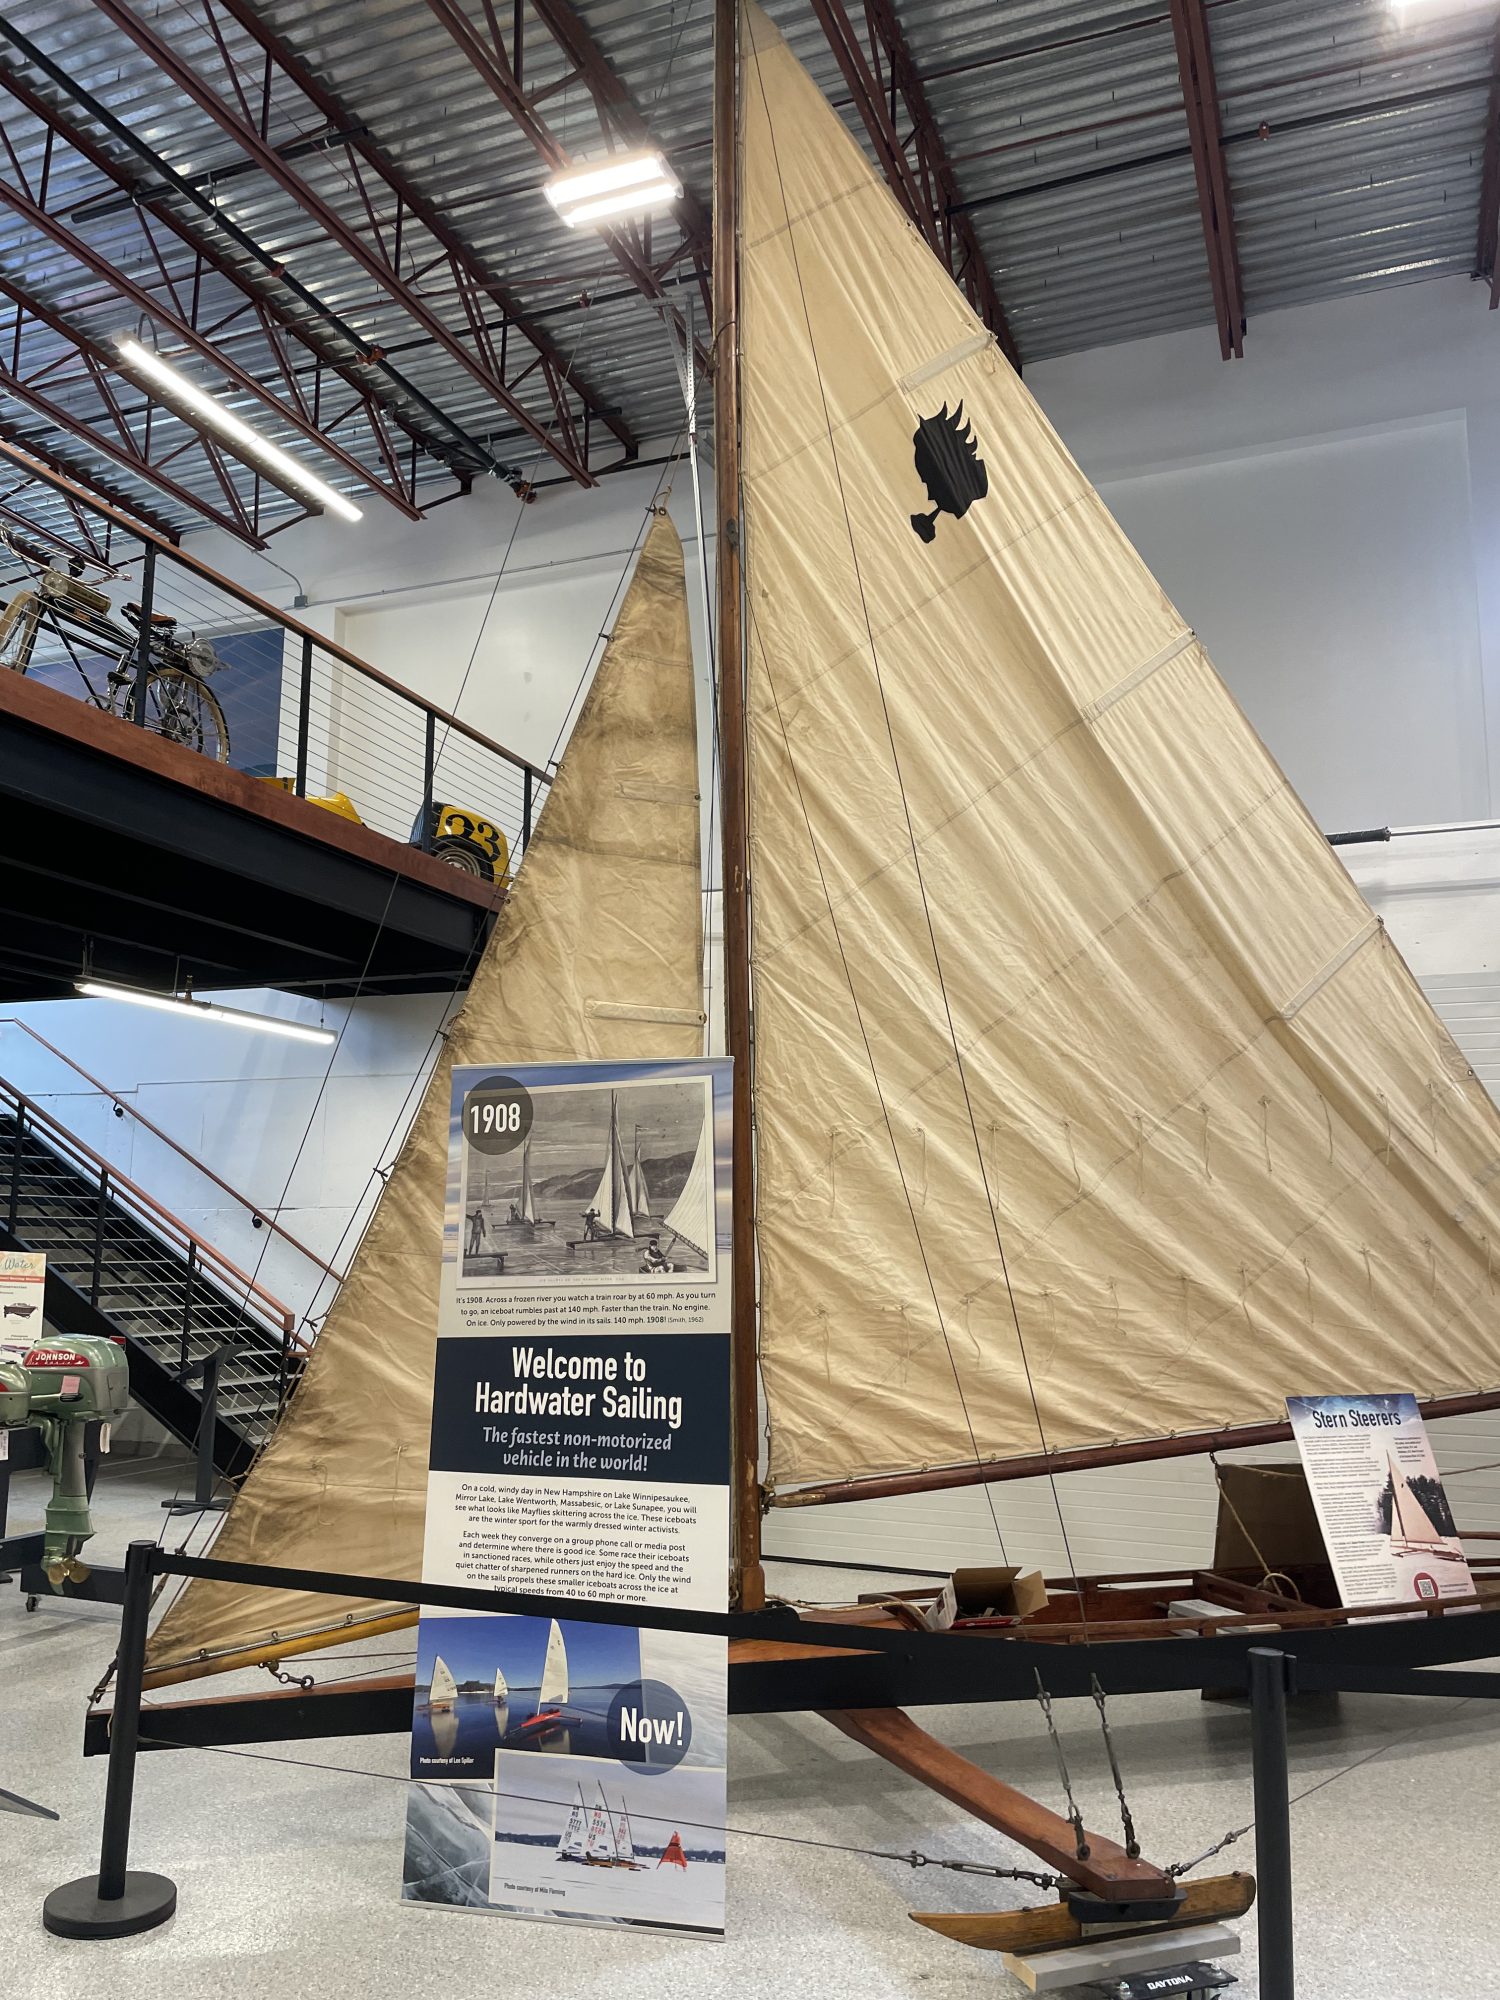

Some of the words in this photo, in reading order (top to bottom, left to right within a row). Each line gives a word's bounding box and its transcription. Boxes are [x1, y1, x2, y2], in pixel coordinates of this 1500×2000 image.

[471, 1102, 520, 1133] 1908
[5, 1258, 34, 1270] Water
[512, 1347, 617, 1380] Welcome
[624, 1352, 645, 1381] to
[475, 1382, 596, 1416] Hardwater
[602, 1386, 682, 1428] Sailing
[1312, 1410, 1347, 1428] Stern
[1348, 1409, 1401, 1426] Steerers
[482, 1426, 508, 1442] The
[509, 1428, 560, 1448] fastest
[564, 1433, 671, 1449] non-motorized
[503, 1450, 552, 1466] vehicle
[556, 1451, 569, 1467] in
[573, 1452, 596, 1468] the
[600, 1454, 647, 1471] world!
[498, 1487, 519, 1495] windy
[521, 1488, 533, 1496] day
[563, 1490, 601, 1498] Hampshire
[633, 1493, 690, 1502] Winnipesaukee,
[516, 1498, 559, 1506] Wentworth,
[561, 1500, 604, 1508] Massabesic,
[633, 1503, 666, 1512] Sunapee,
[522, 1508, 550, 1516] Mayflies
[553, 1510, 587, 1519] skittering
[641, 1514, 662, 1522] These
[502, 1534, 516, 1542] they
[518, 1536, 552, 1544] converge
[511, 1566, 549, 1574] sharpened
[639, 1573, 656, 1582] Only
[621, 1706, 683, 1745] Now!
[1147, 1975, 1193, 1990] DAYTONA
